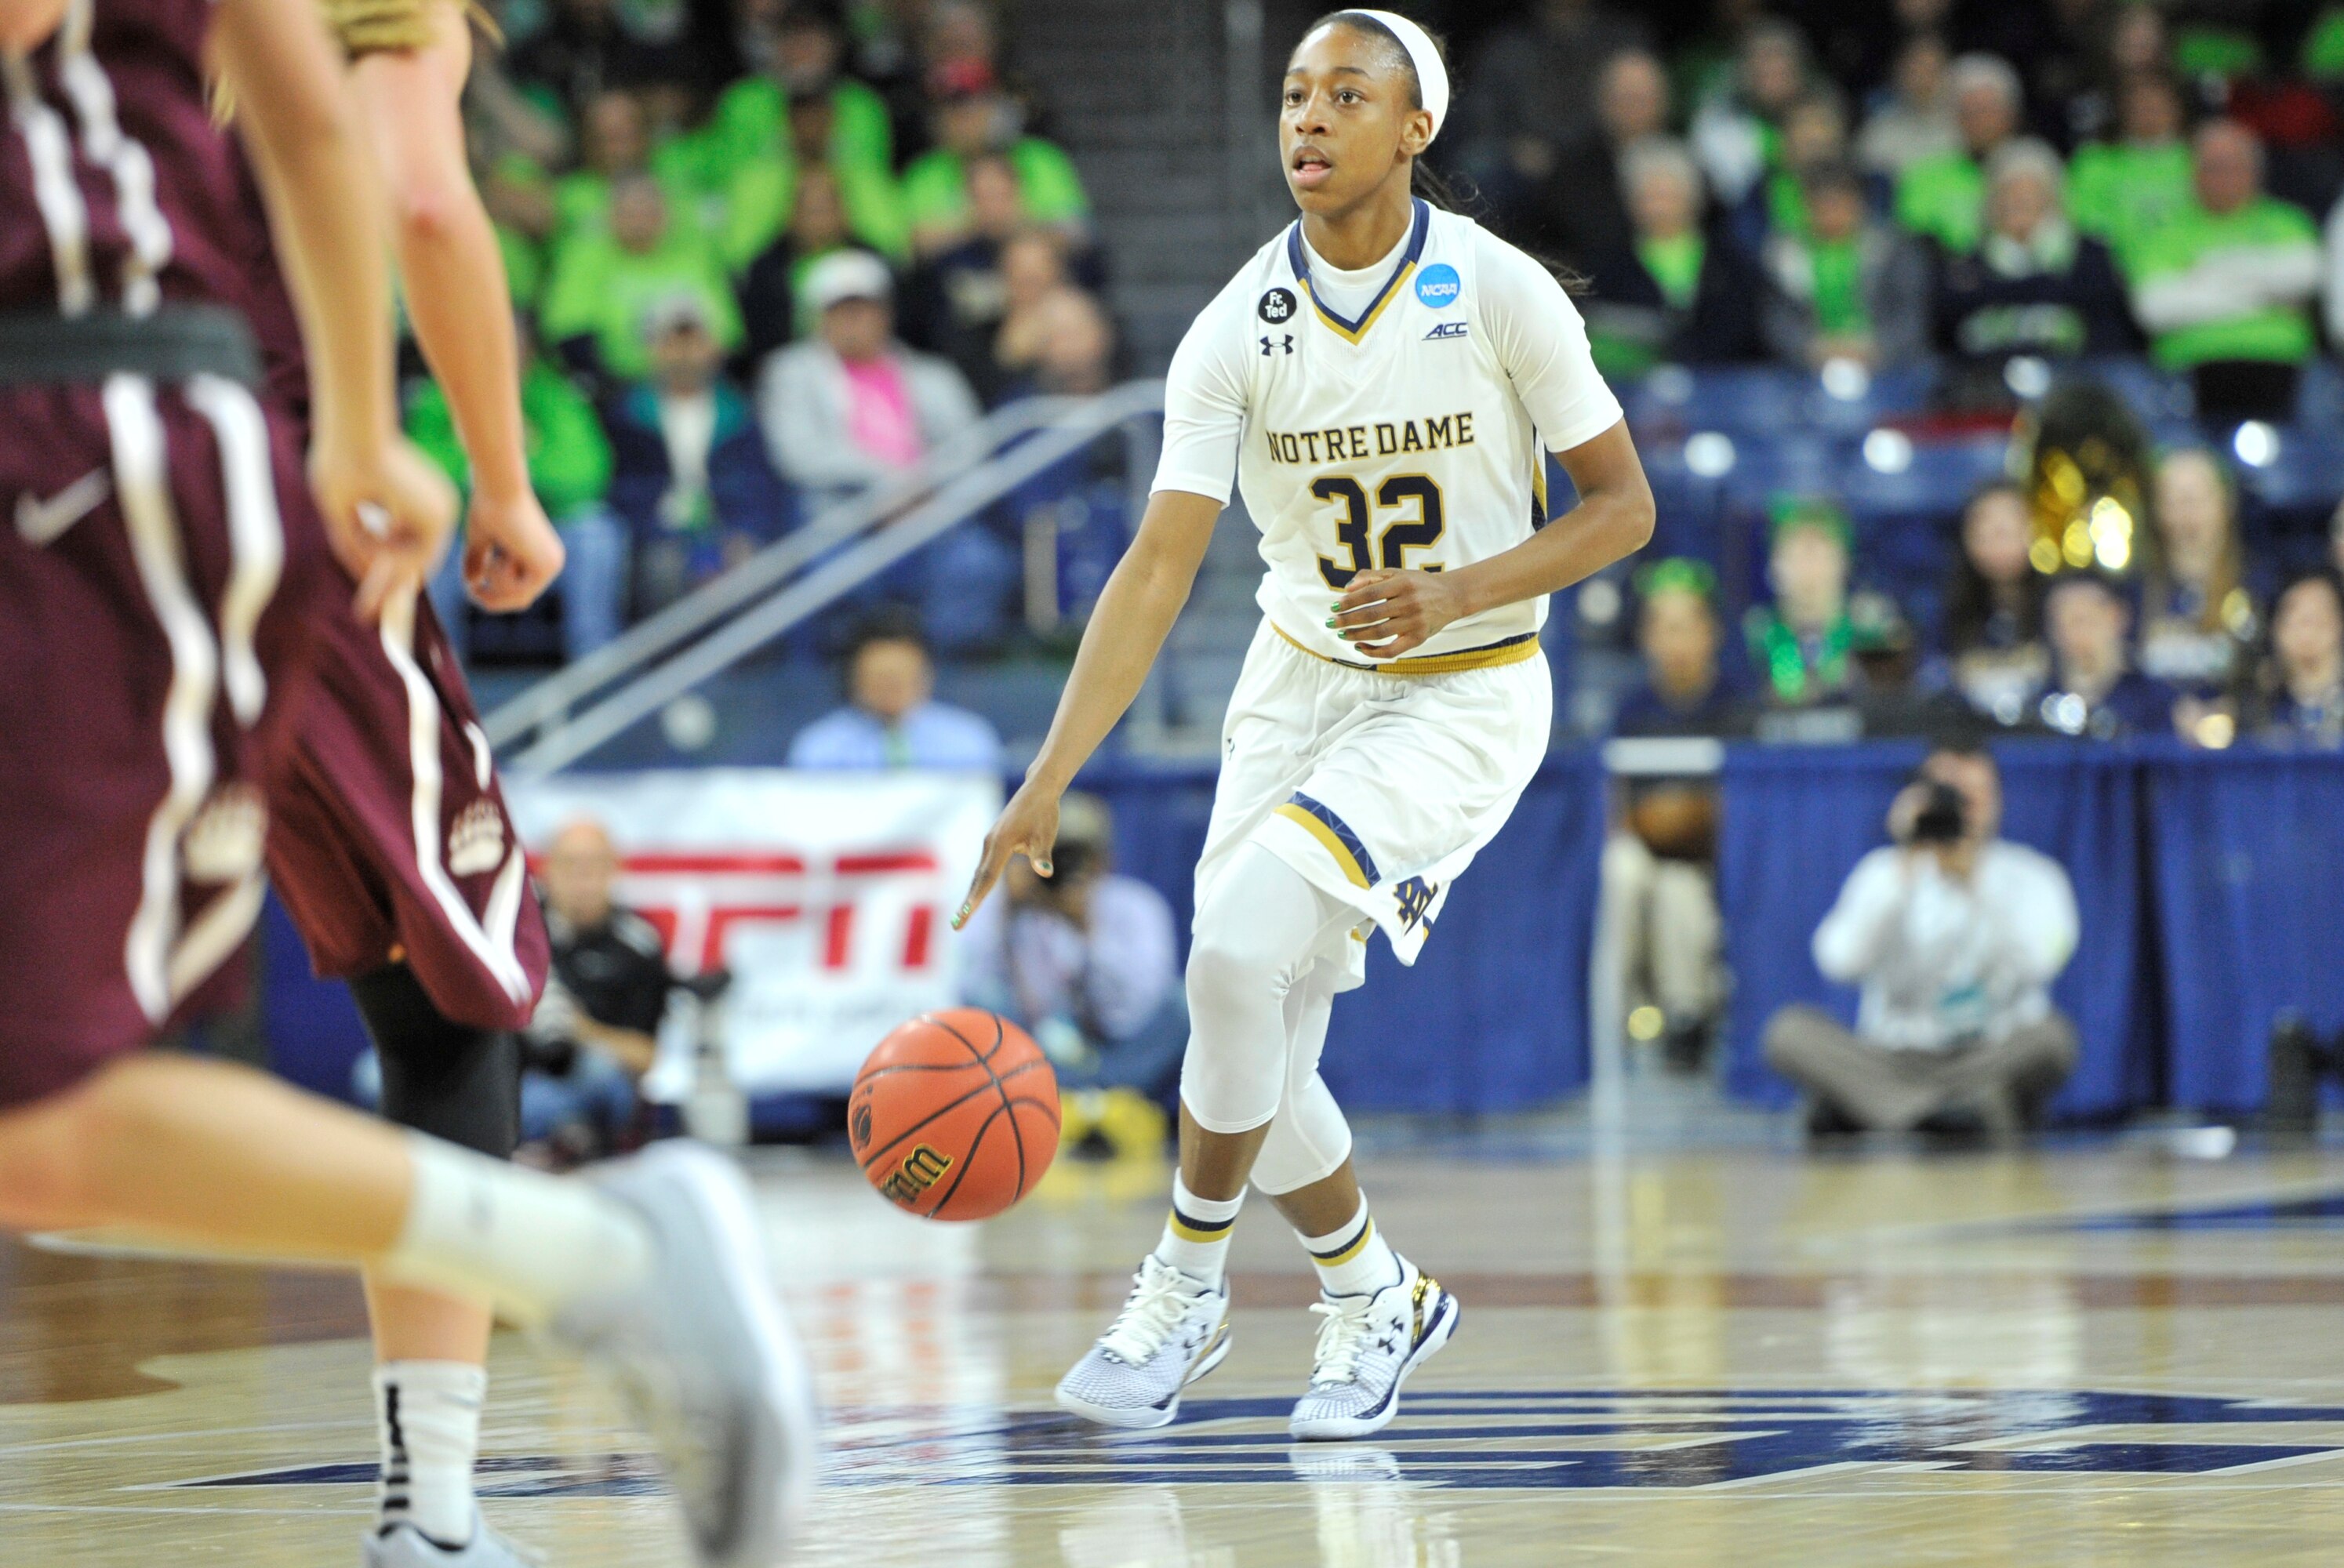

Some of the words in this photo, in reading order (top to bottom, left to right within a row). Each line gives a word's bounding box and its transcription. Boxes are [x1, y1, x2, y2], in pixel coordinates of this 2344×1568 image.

[1420, 283, 1458, 297] NCAA
[1264, 303, 1288, 318] Ted
[1426, 322, 1468, 338] ACC
[1266, 425, 1369, 465] NOTRE
[1374, 410, 1476, 457] DAME
[1308, 472, 1446, 593] 32
